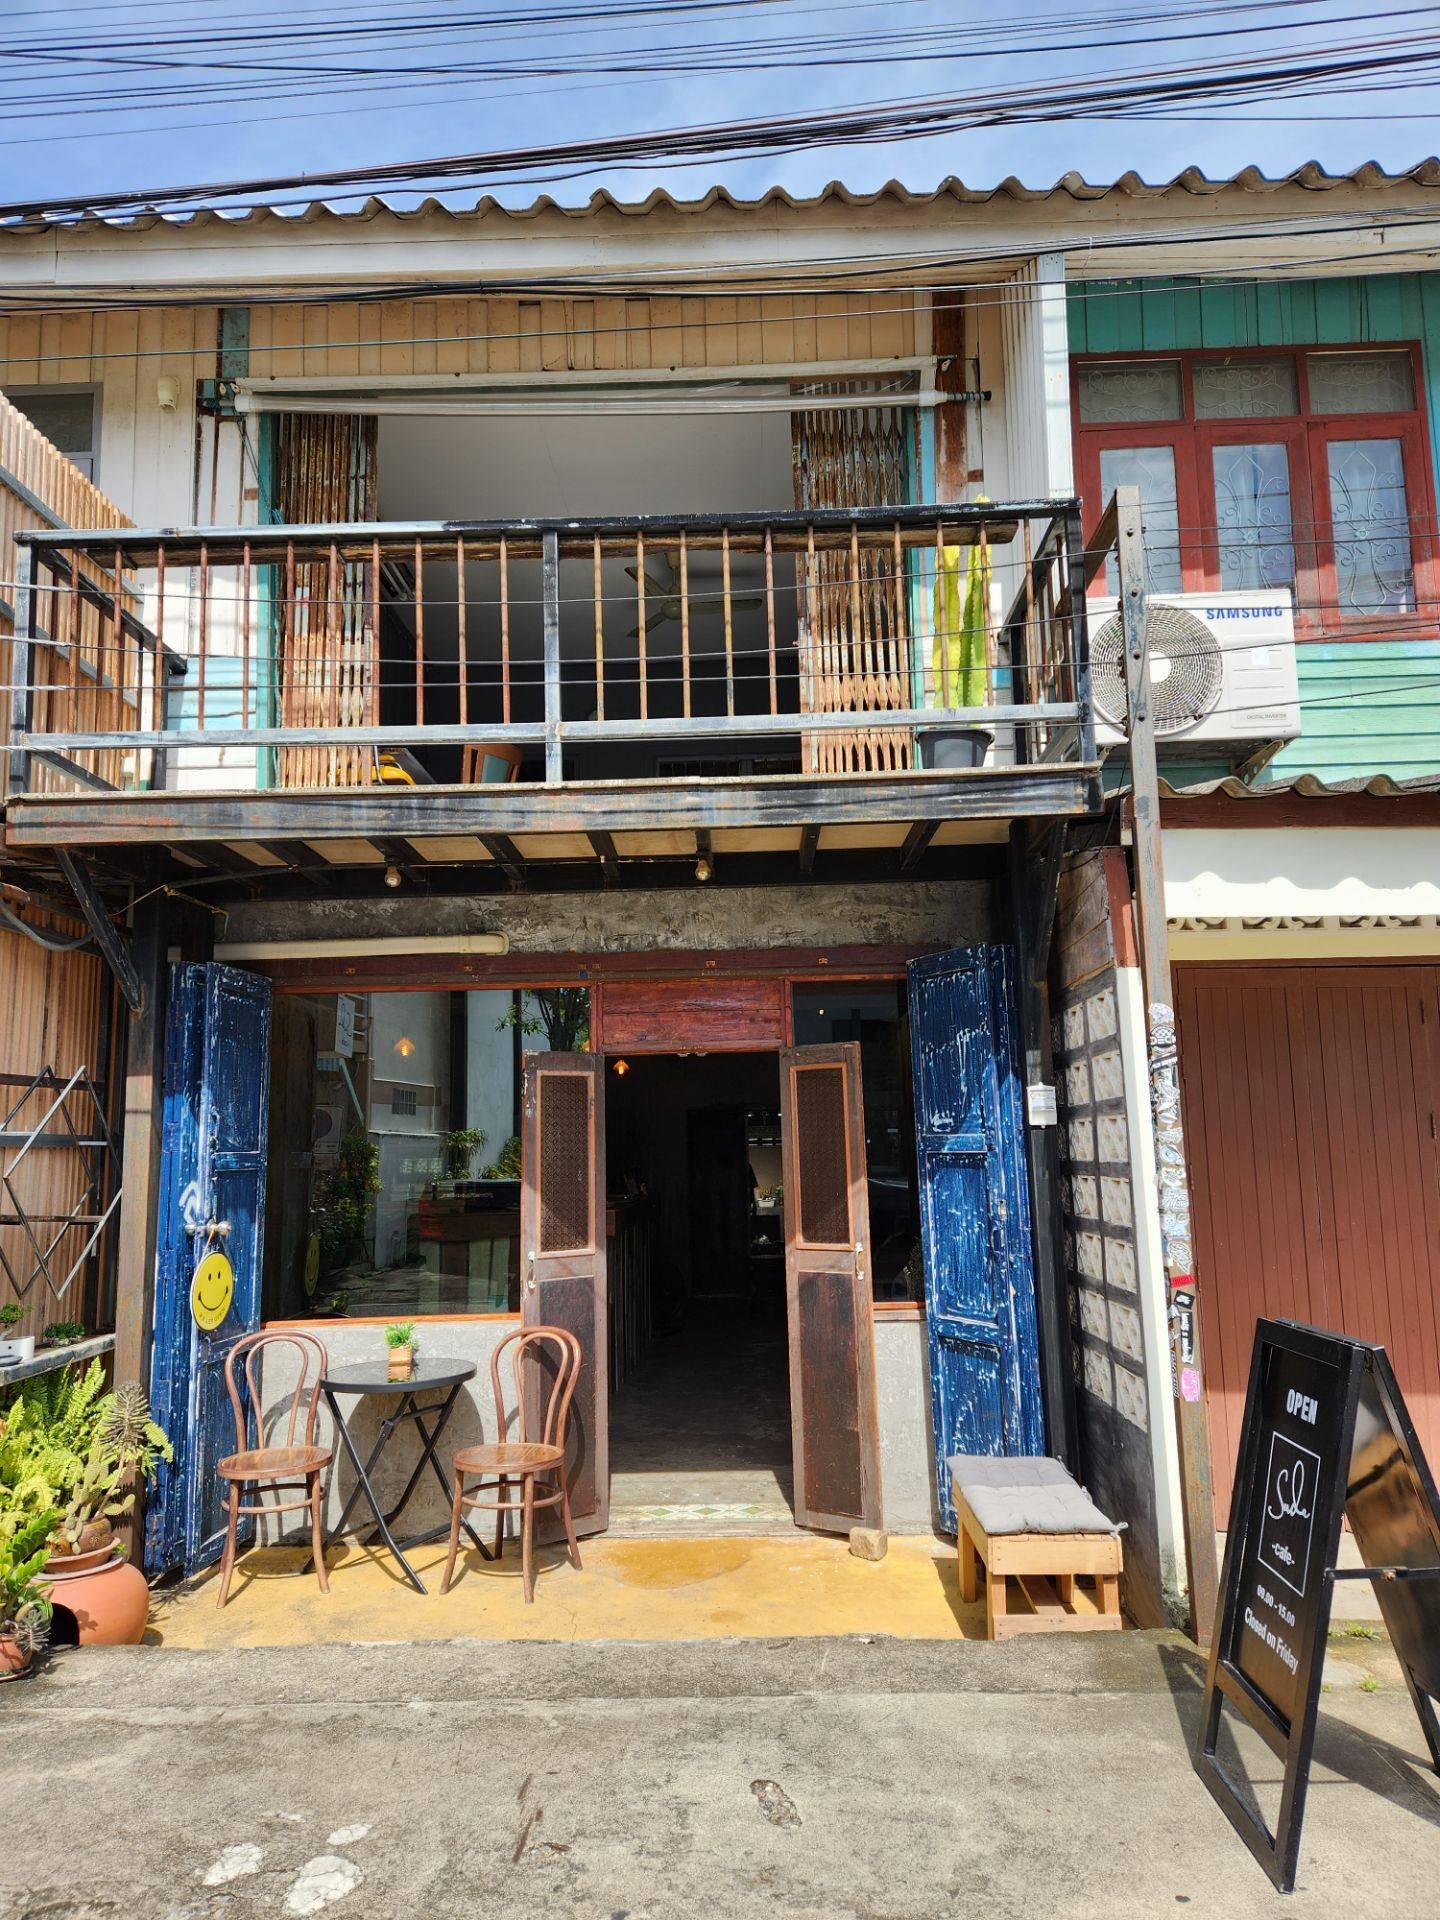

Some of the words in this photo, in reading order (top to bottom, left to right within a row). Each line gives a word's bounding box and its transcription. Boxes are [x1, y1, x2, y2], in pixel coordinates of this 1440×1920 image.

[1206, 607, 1283, 620] SAMSUNG
[1286, 1388, 1318, 1425] OPEN
[1278, 1603, 1296, 1628] 15.00
[1244, 1606, 1267, 1641] Closed
[1266, 1632, 1276, 1650] on
[1276, 1638, 1299, 1676] Friday
